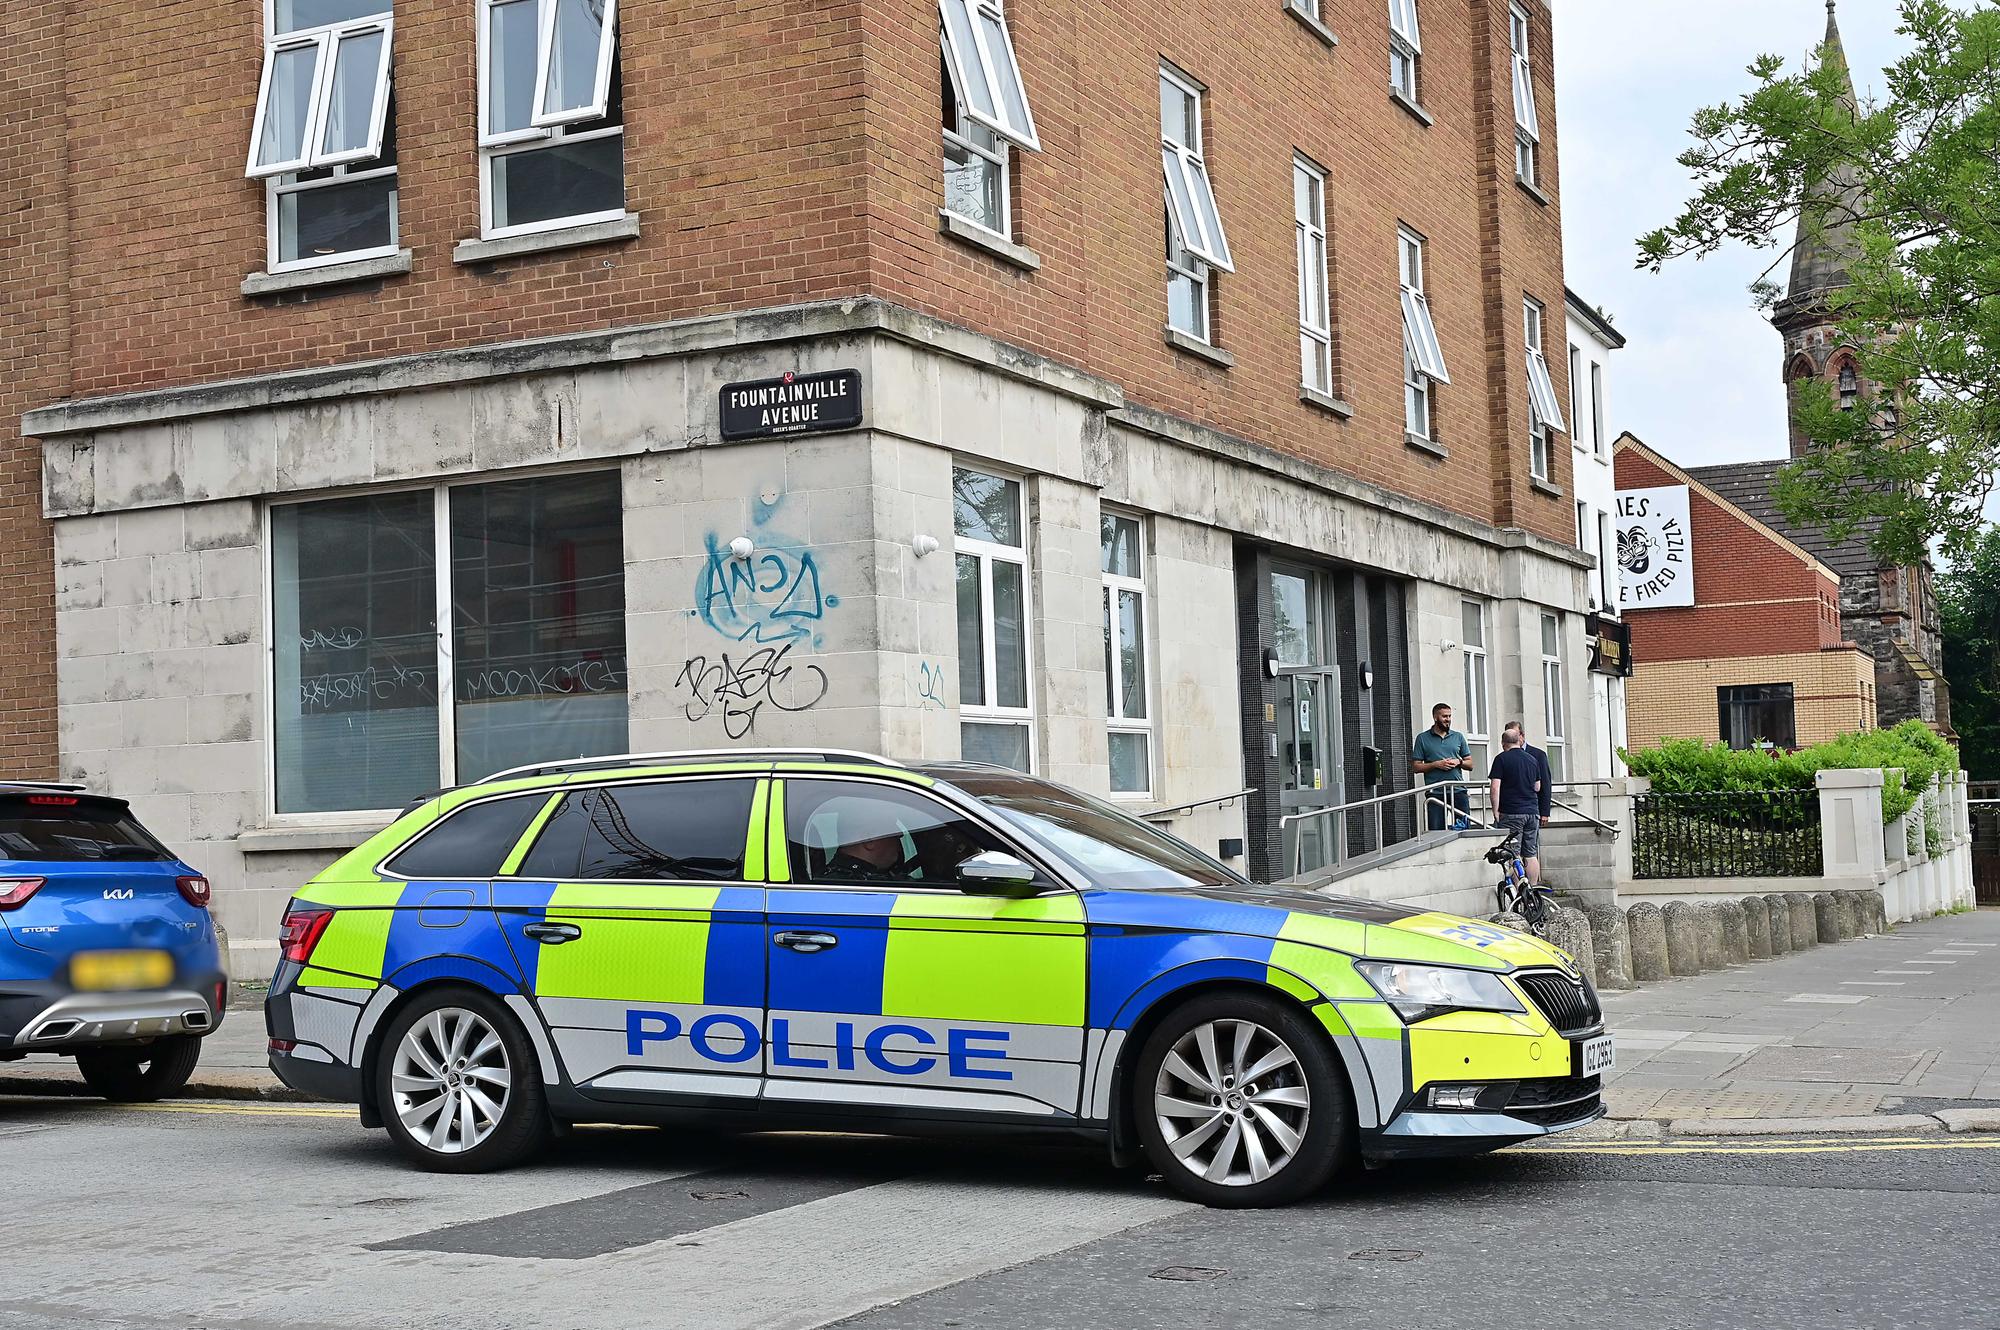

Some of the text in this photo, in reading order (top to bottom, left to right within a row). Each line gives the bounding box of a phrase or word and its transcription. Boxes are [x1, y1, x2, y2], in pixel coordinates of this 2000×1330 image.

[731, 379, 847, 409] FOUNTAINVILLE
[761, 403, 819, 426] AVENUE
[1635, 567, 1676, 602] FIRED
[1662, 518, 1684, 562] PIZZA
[103, 889, 134, 900] KIA
[626, 1009, 1013, 1081] POLICE
